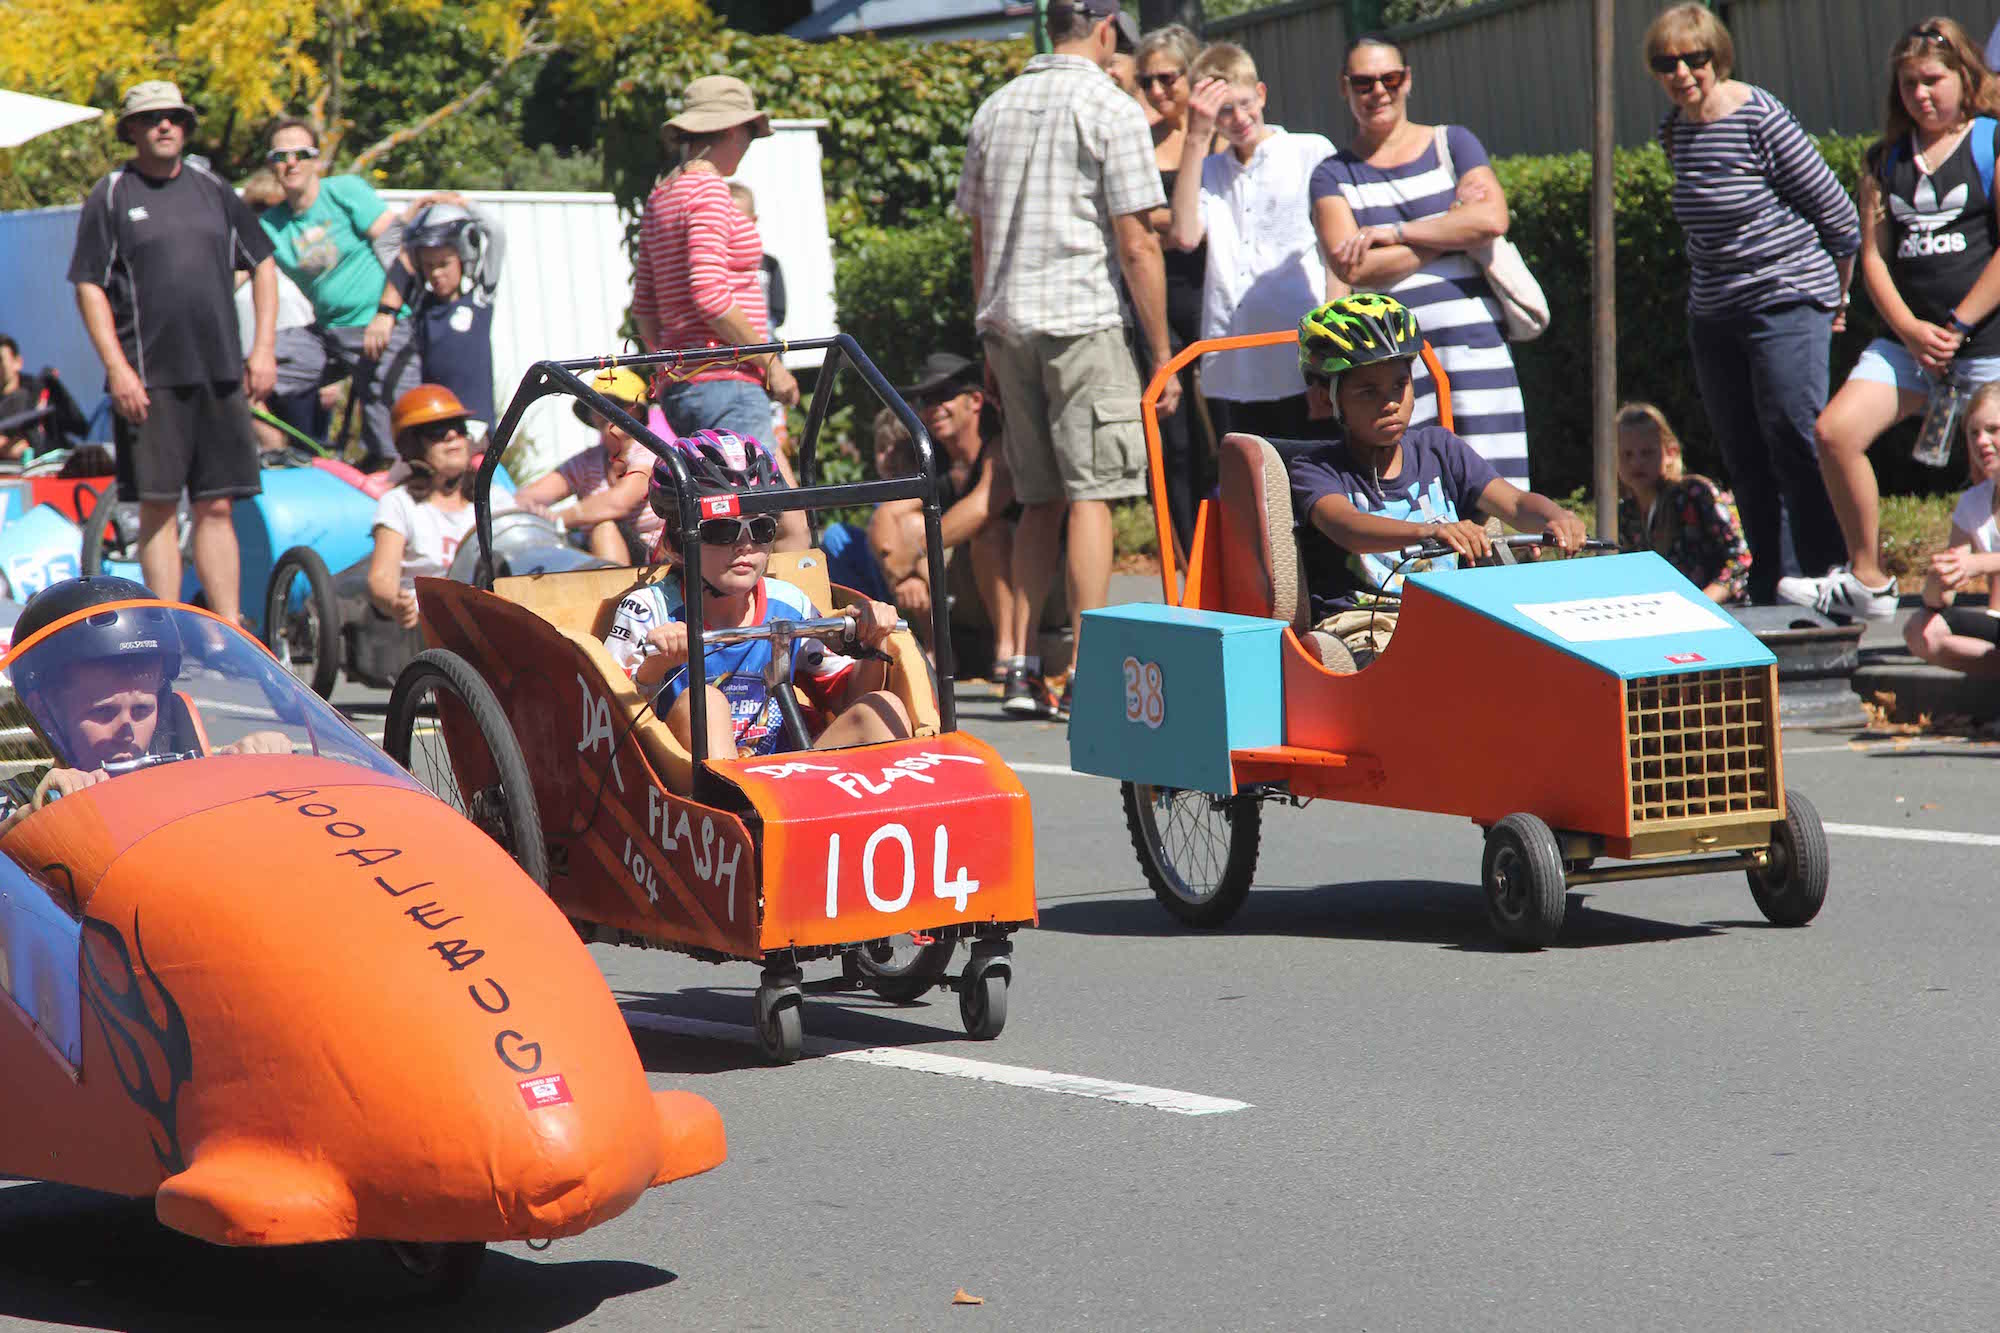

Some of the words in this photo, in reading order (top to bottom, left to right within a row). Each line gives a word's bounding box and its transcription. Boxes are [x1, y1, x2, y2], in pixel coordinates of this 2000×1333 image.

[1123, 656, 1164, 728] 38
[577, 673, 624, 793] DA
[649, 785, 742, 922] FLASH
[744, 762, 839, 779] DA
[827, 752, 985, 799] FLASH
[623, 837, 659, 904] 104
[826, 823, 980, 918] 104
